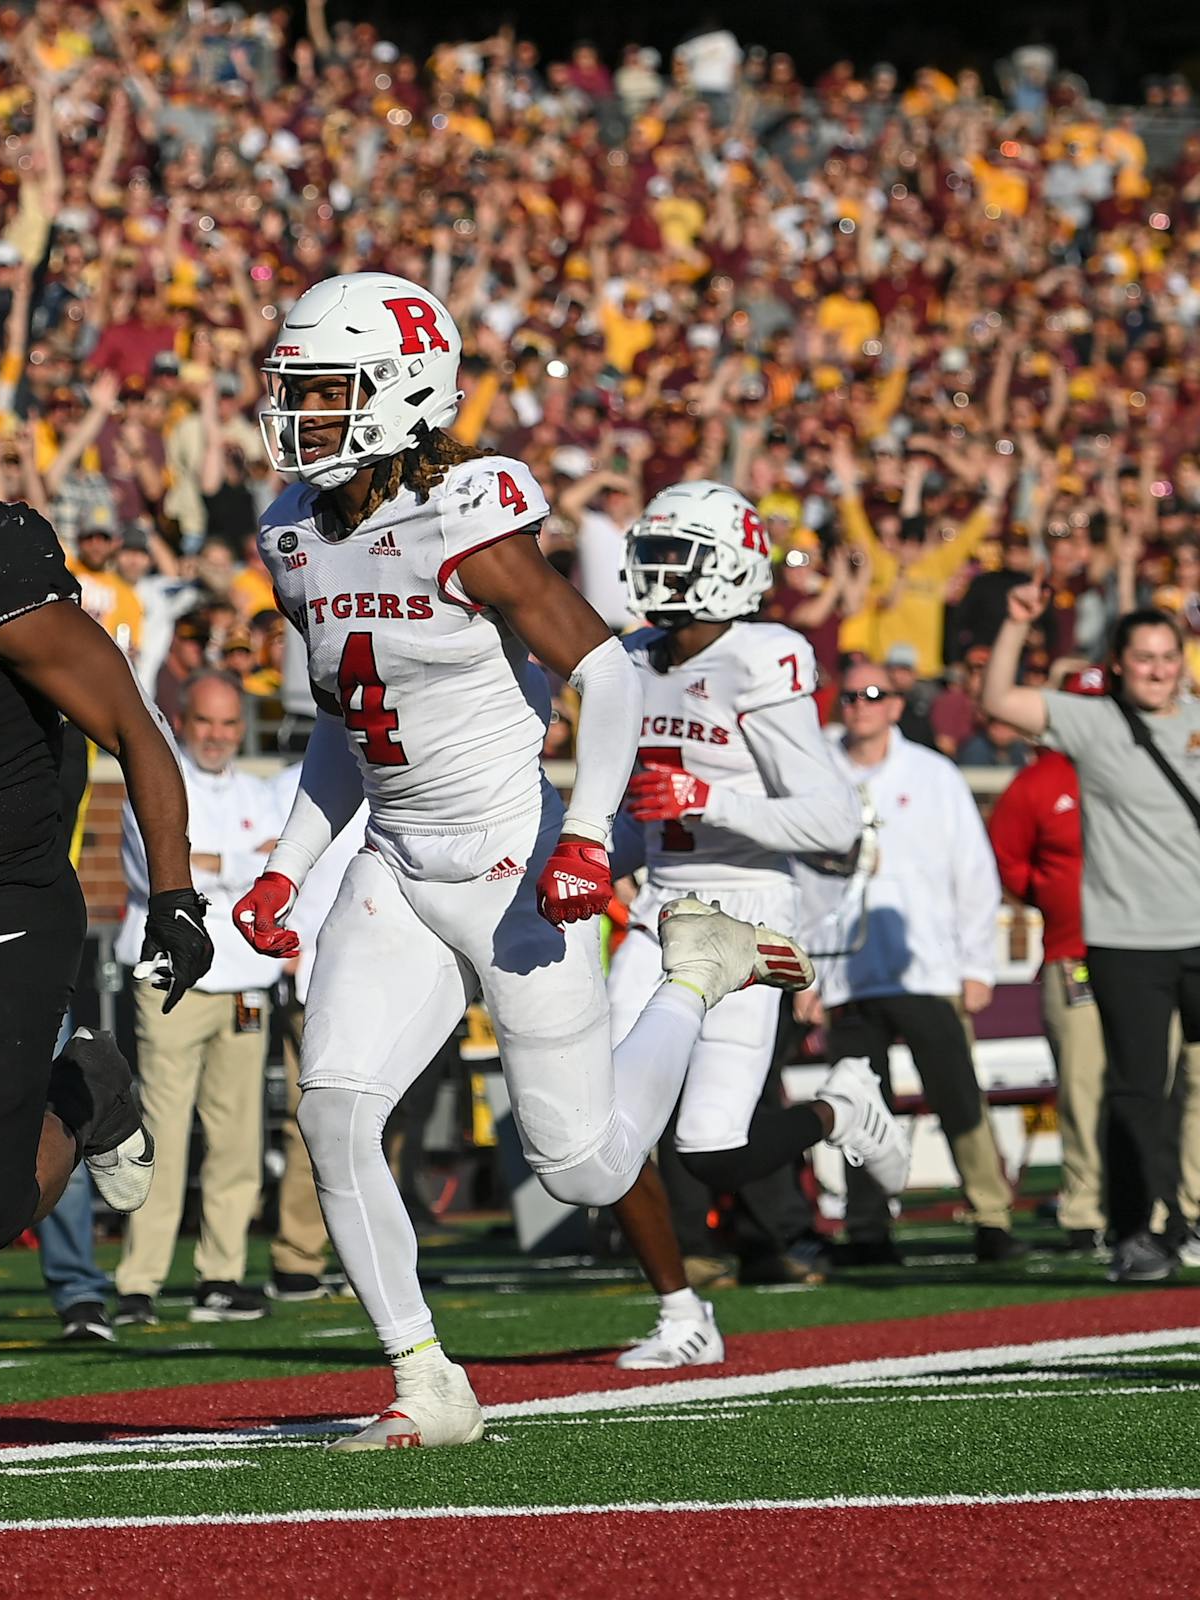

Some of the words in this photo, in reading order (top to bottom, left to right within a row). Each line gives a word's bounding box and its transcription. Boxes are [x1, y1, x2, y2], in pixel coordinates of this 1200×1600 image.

[382, 297, 450, 355] R
[496, 470, 529, 516] 4
[368, 546, 402, 556] adidas
[778, 654, 802, 692] 7
[338, 631, 410, 766] 4
[641, 716, 730, 745] TGERS
[485, 865, 527, 883] adidas
[552, 869, 598, 891] adidas
